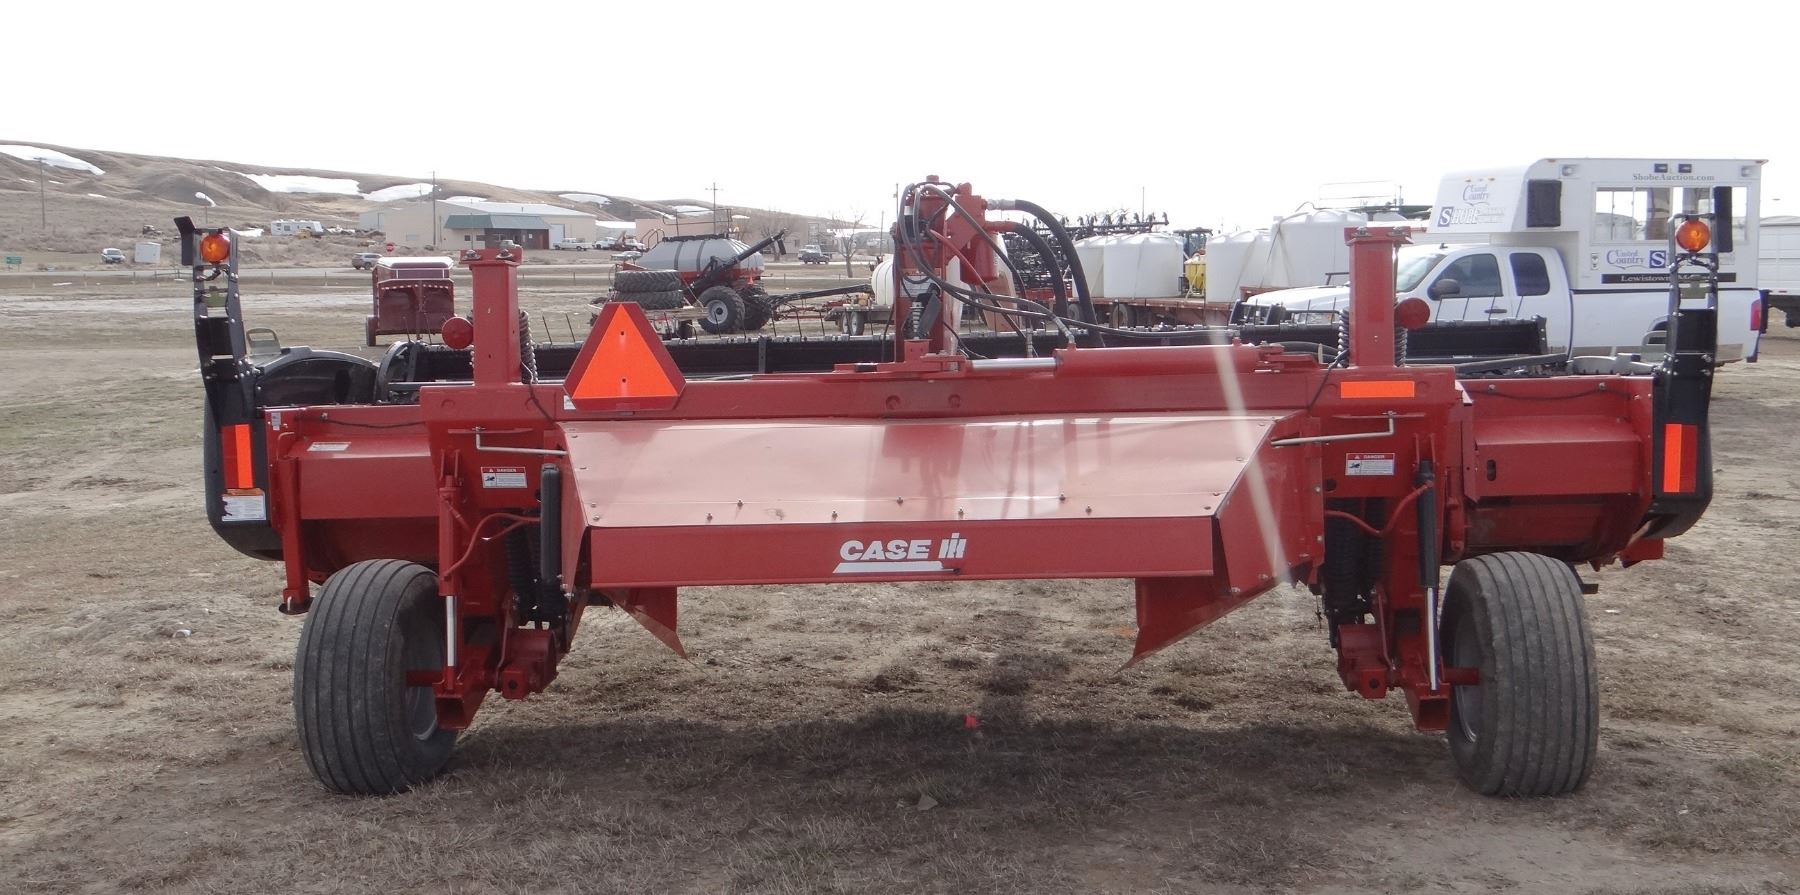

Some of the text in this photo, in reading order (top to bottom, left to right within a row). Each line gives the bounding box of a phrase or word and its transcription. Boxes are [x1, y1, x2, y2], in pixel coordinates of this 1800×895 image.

[1632, 173, 1715, 181] ShobeAuction.com
[1606, 250, 1645, 265] Country
[839, 539, 932, 561] CASE
